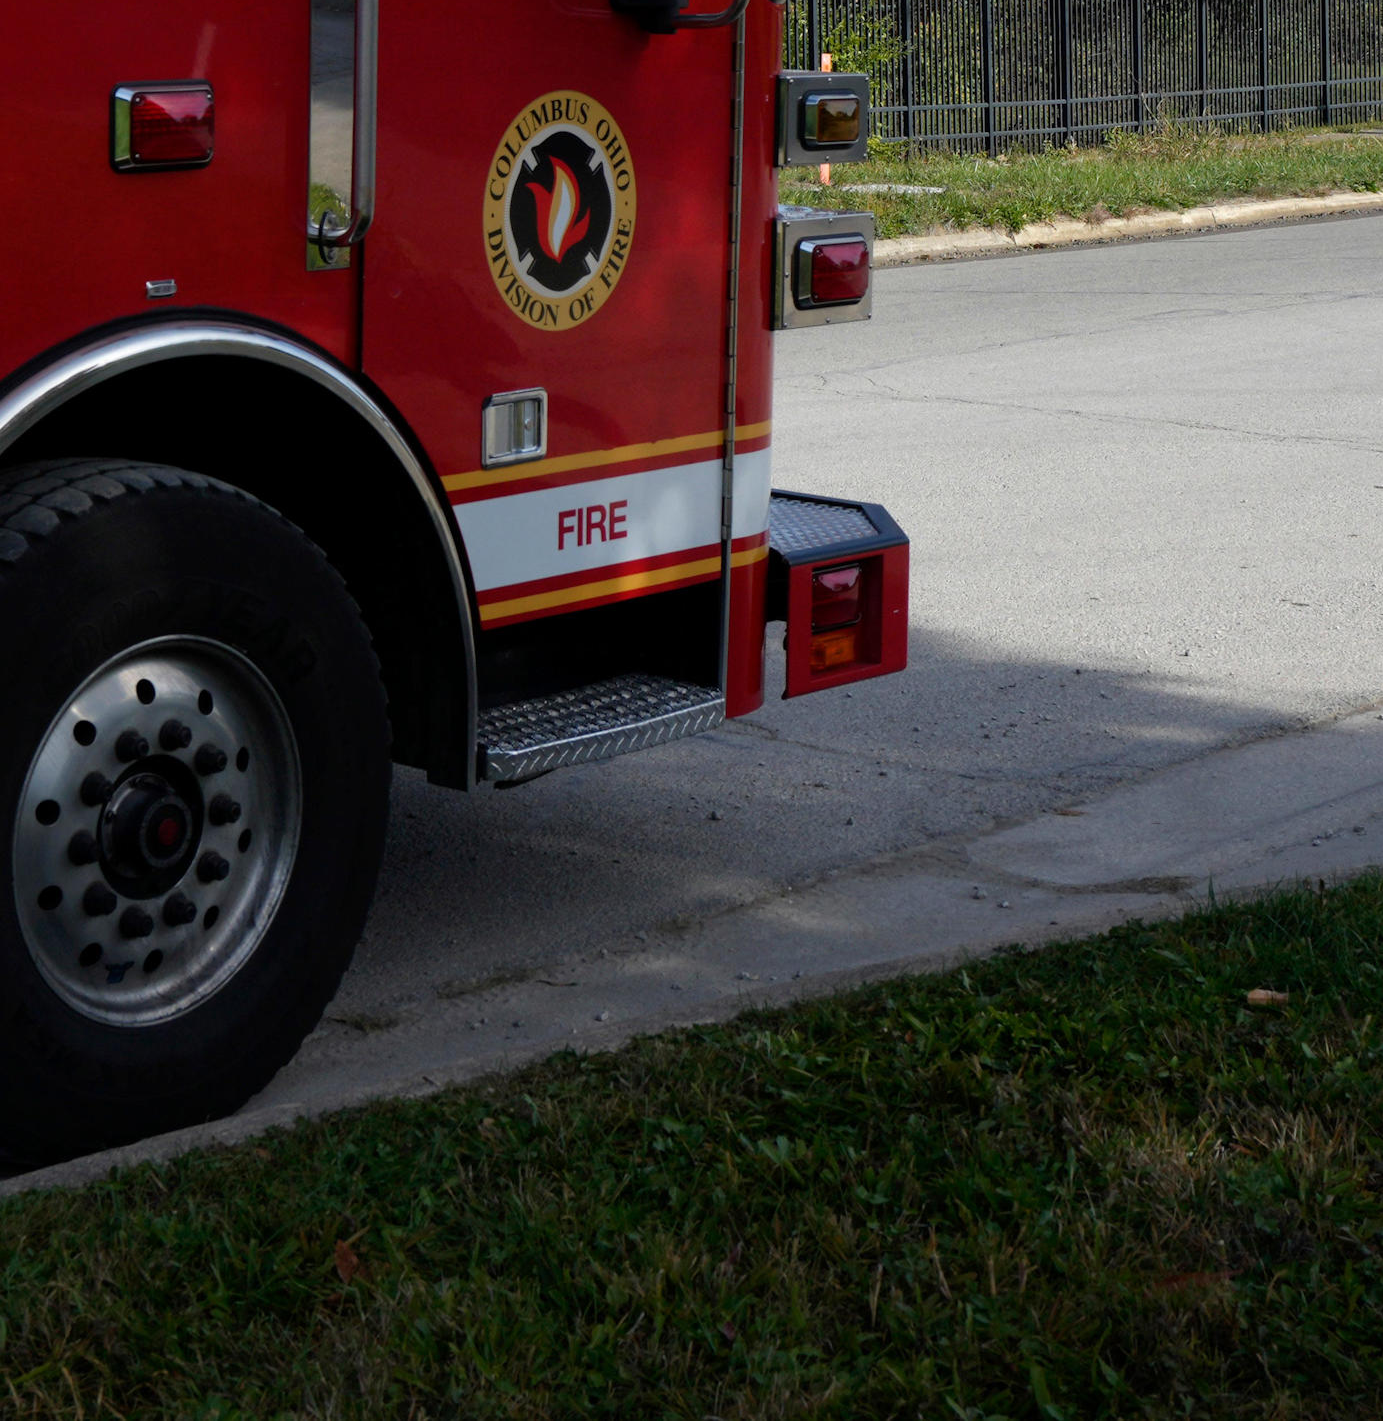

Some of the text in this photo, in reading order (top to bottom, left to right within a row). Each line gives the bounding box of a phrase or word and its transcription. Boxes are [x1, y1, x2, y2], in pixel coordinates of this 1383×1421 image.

[489, 98, 631, 201] COLUMBUS OHIO
[487, 218, 632, 327] DIVISION OF FIRE
[557, 499, 628, 551] FIRE
